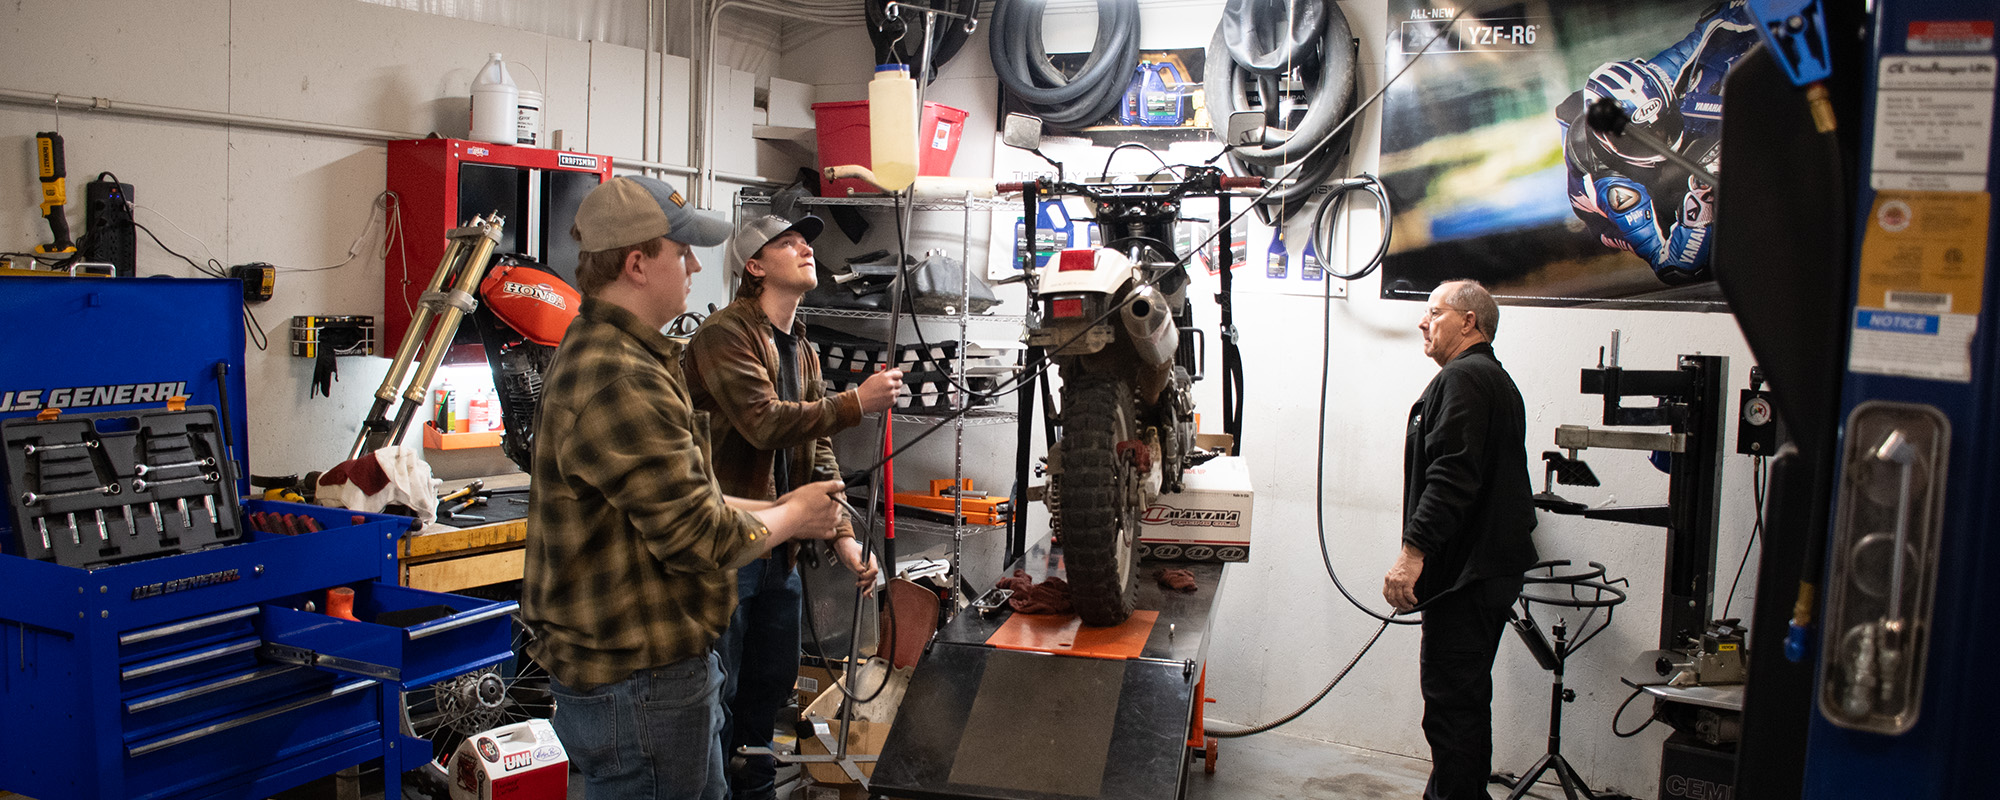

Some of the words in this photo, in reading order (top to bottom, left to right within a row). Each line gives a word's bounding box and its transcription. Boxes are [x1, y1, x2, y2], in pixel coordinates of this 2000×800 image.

[1410, 7, 1455, 19] ALL-NEW
[1468, 25, 1537, 45] YZF-R6
[1638, 101, 1658, 117] Arai
[561, 156, 596, 167] CRAFTSMAN
[503, 281, 566, 310] HONDA
[1869, 313, 1927, 330] NOTICE
[48, 381, 192, 409] GENERAL
[164, 568, 240, 594] GENERAL
[505, 752, 531, 771] UNI
